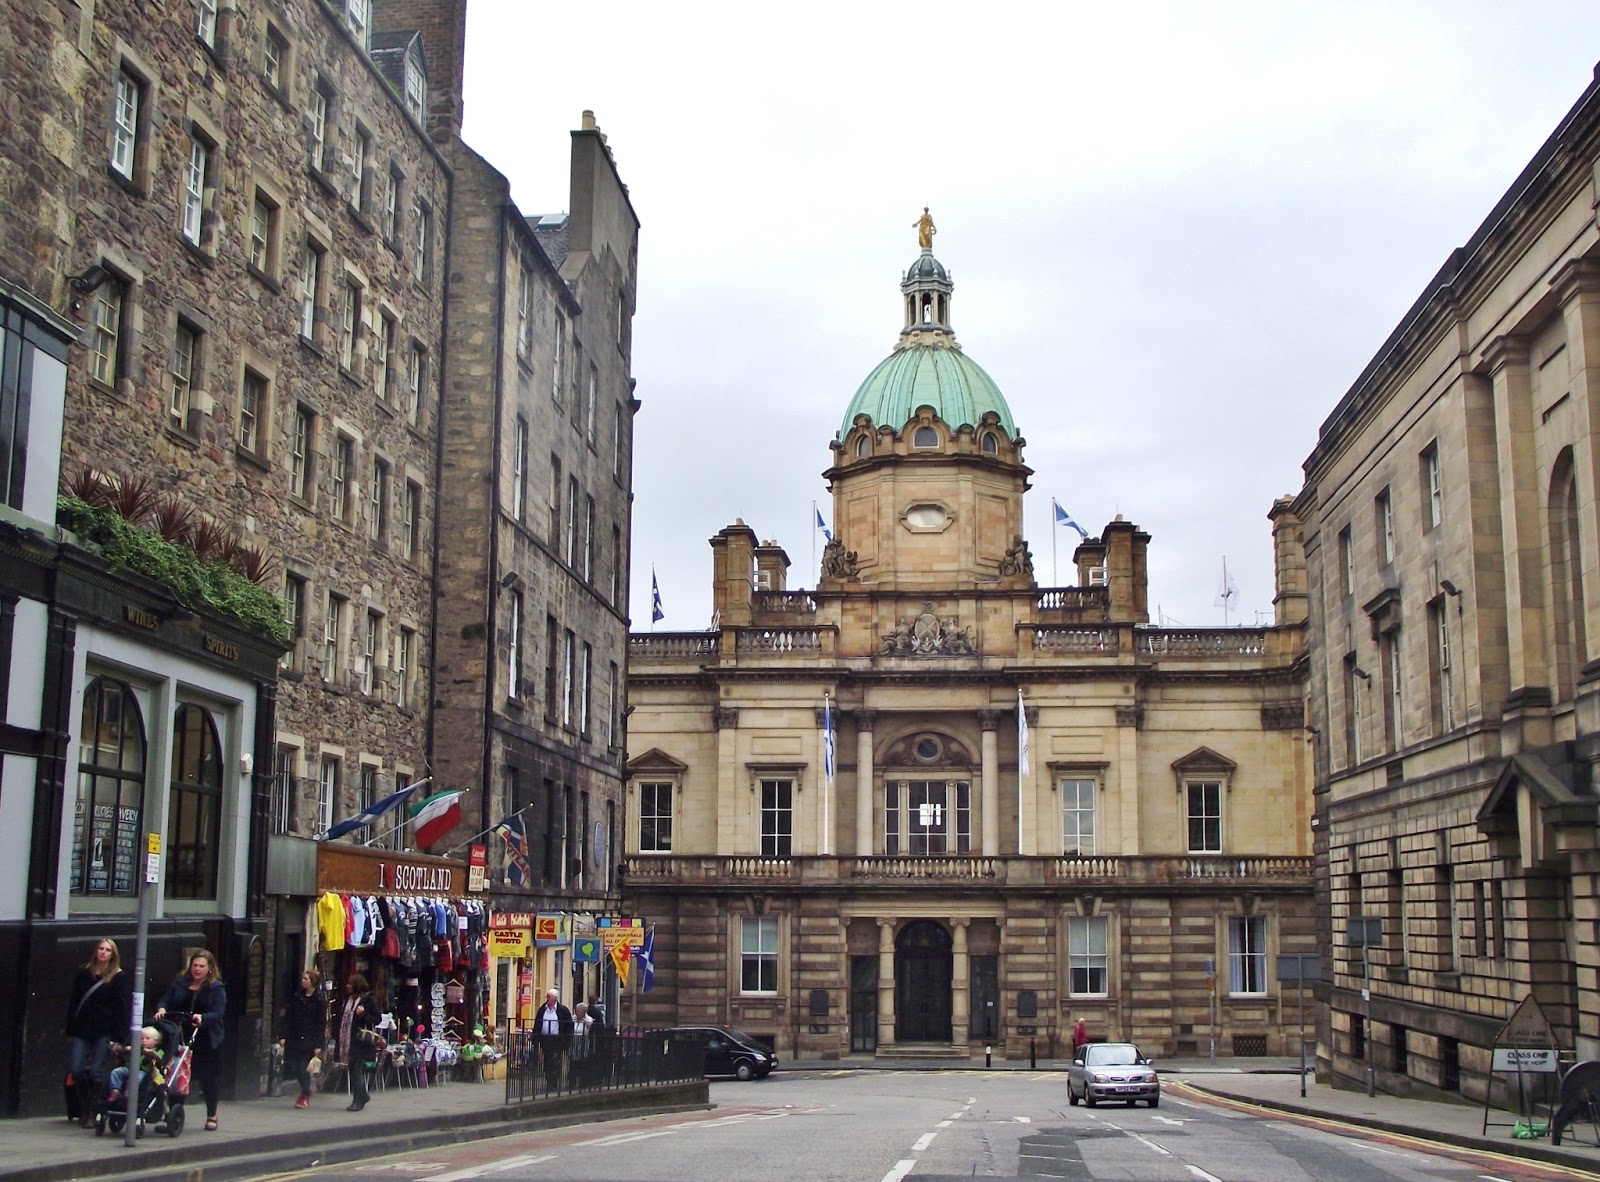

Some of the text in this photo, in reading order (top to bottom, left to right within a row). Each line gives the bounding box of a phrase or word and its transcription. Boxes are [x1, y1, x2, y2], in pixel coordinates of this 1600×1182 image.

[126, 605, 239, 660] WINES SPIRITS
[379, 864, 452, 891] I SCOTLAND
